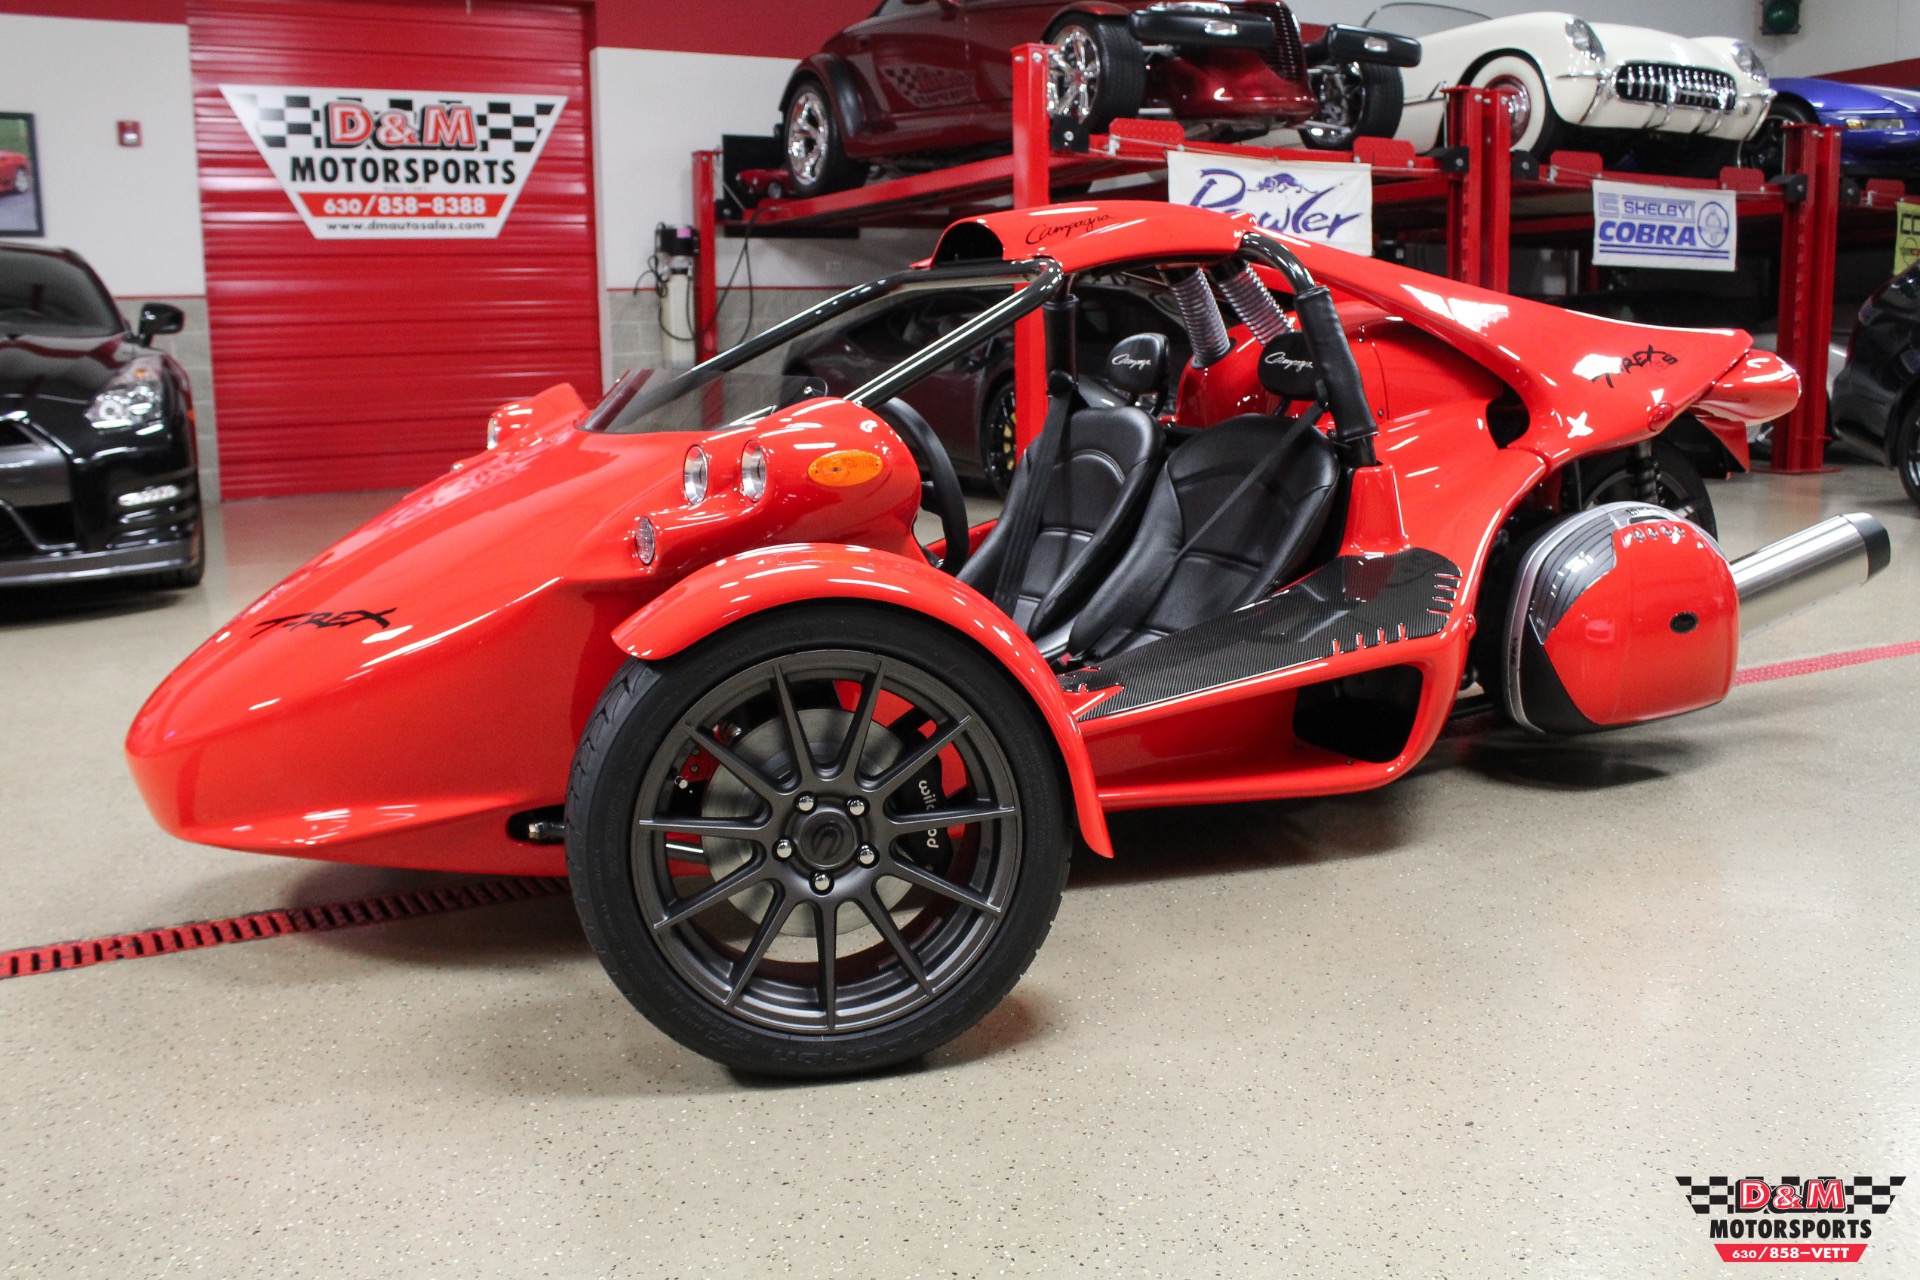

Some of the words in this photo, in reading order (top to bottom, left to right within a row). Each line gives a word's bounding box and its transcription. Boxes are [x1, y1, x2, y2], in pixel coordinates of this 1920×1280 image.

[325, 102, 478, 150] D&M
[290, 156, 516, 185] MOTORSPORTS
[323, 195, 487, 216] 630/858-8388
[1190, 168, 1364, 239] Pwler
[1623, 201, 1689, 217] SHELBY
[326, 219, 485, 231] www.dmautosales.com
[1599, 220, 1696, 246] COBRA
[249, 607, 398, 639] T-REX
[918, 780, 940, 849] wilod
